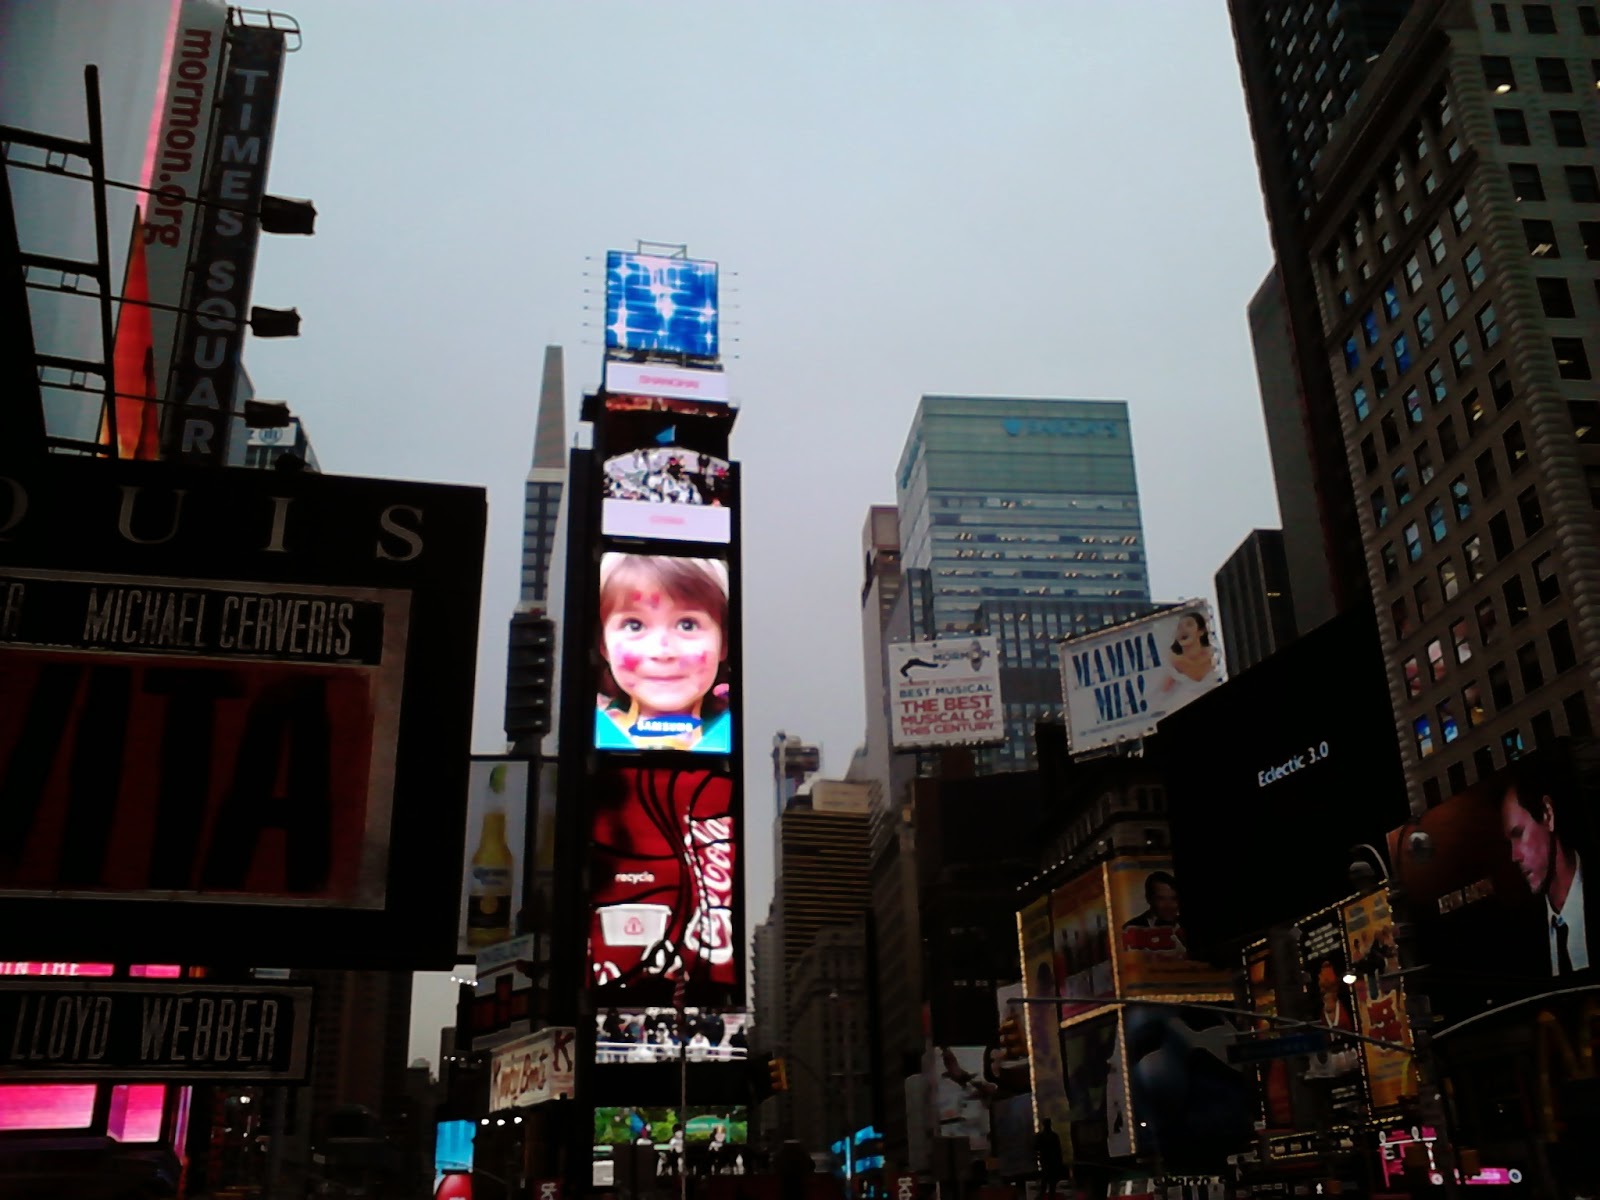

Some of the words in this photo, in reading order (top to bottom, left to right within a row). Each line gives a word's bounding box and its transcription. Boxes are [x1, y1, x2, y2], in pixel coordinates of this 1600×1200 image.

[143, 28, 212, 248] mormon.org
[214, 68, 270, 238] TIMES
[83, 586, 208, 648] MICHAEL
[219, 596, 354, 656] CERVERIS
[1072, 632, 1161, 690] MAMMA
[899, 687, 930, 699] BEST
[936, 683, 992, 695] MUSICAL
[901, 698, 939, 714] THE
[944, 694, 993, 711] BEST
[1094, 674, 1147, 724] MIA!
[636, 720, 694, 732] SAMSUNG
[900, 710, 969, 726] MUSICAL
[973, 708, 993, 721] OF
[934, 721, 994, 734] CENTURY
[1258, 754, 1306, 787] Eclectic
[1307, 741, 1329, 765] 3.0
[614, 871, 655, 884] recycle
[9, 994, 113, 1061] LLOYD
[138, 994, 279, 1062] WEBBER
